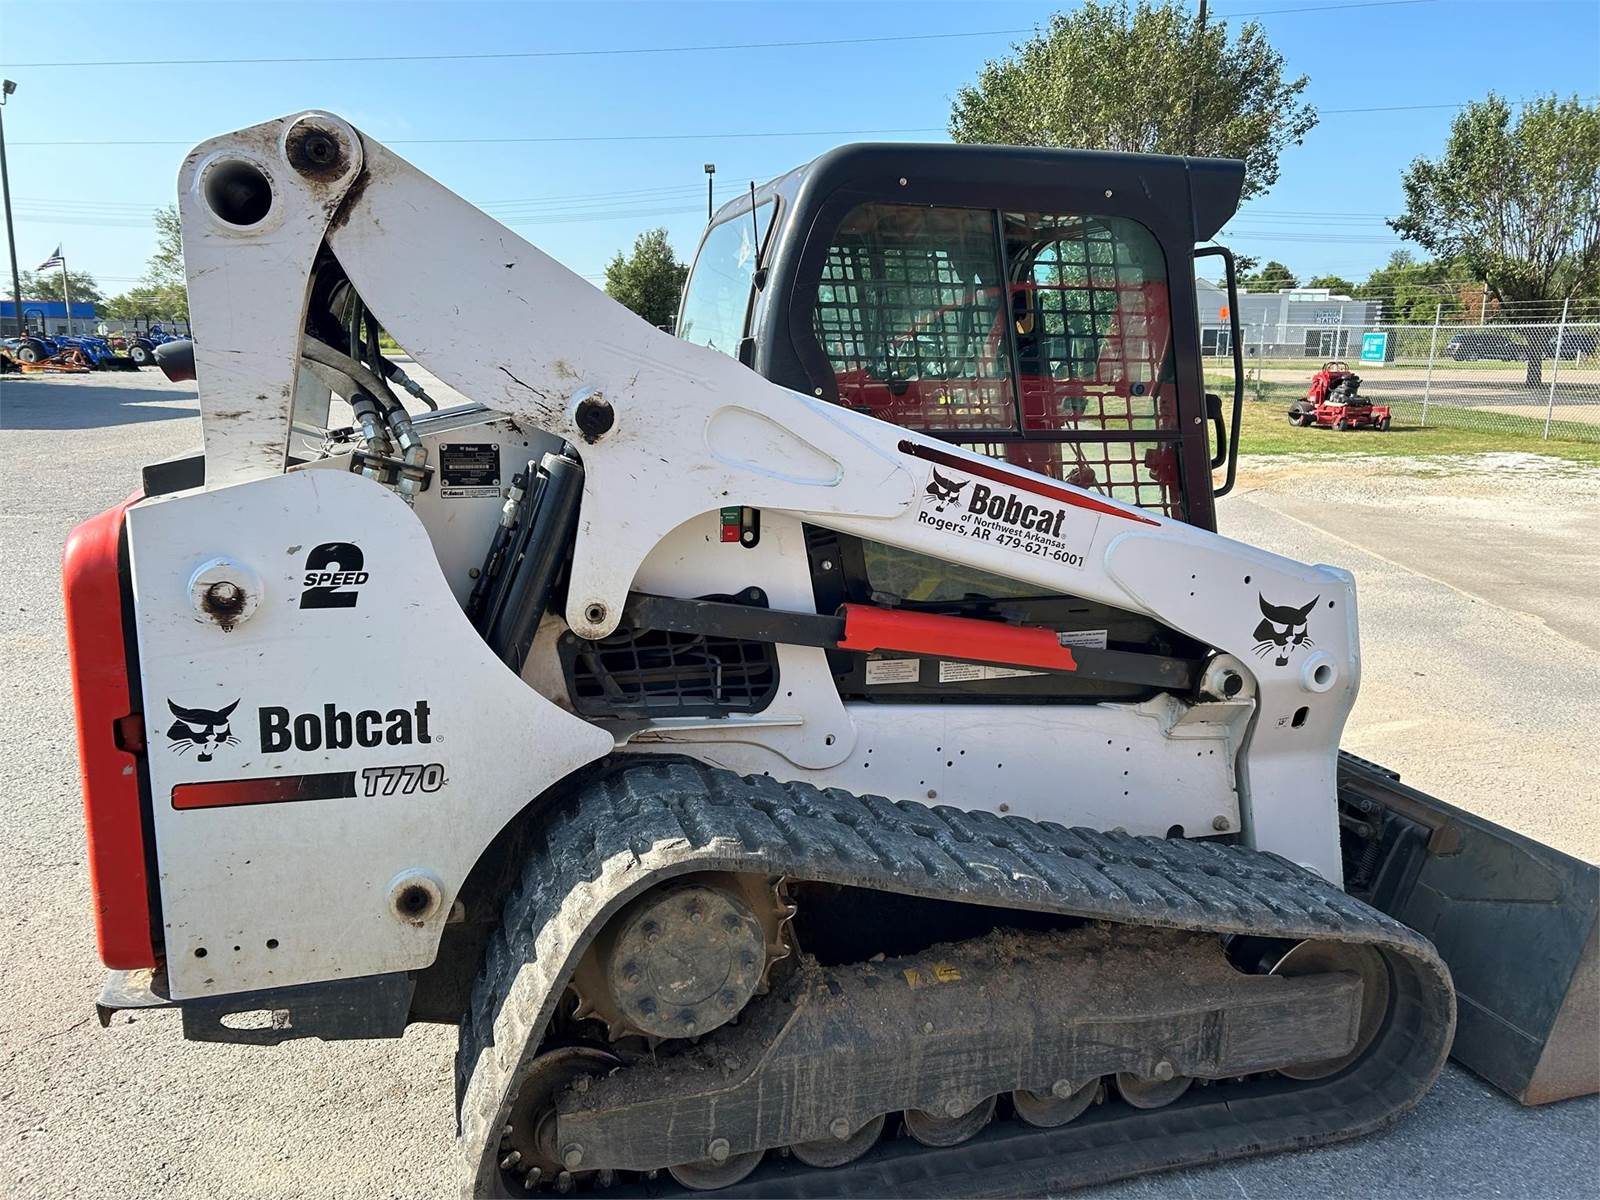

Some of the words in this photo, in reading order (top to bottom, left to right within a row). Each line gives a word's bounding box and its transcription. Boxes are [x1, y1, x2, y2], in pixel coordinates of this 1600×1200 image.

[960, 513, 973, 524] of
[973, 516, 1023, 538] Northwest
[1024, 531, 1066, 550] Arkansas
[967, 483, 1066, 539] Bobcat
[917, 510, 968, 536] Rogers,
[971, 526, 992, 541] AR
[995, 534, 1085, 568] 479-621-6001
[299, 541, 366, 610] 2
[303, 571, 369, 587] SPEED
[258, 700, 432, 754] Bobcat
[361, 763, 446, 798] T770
